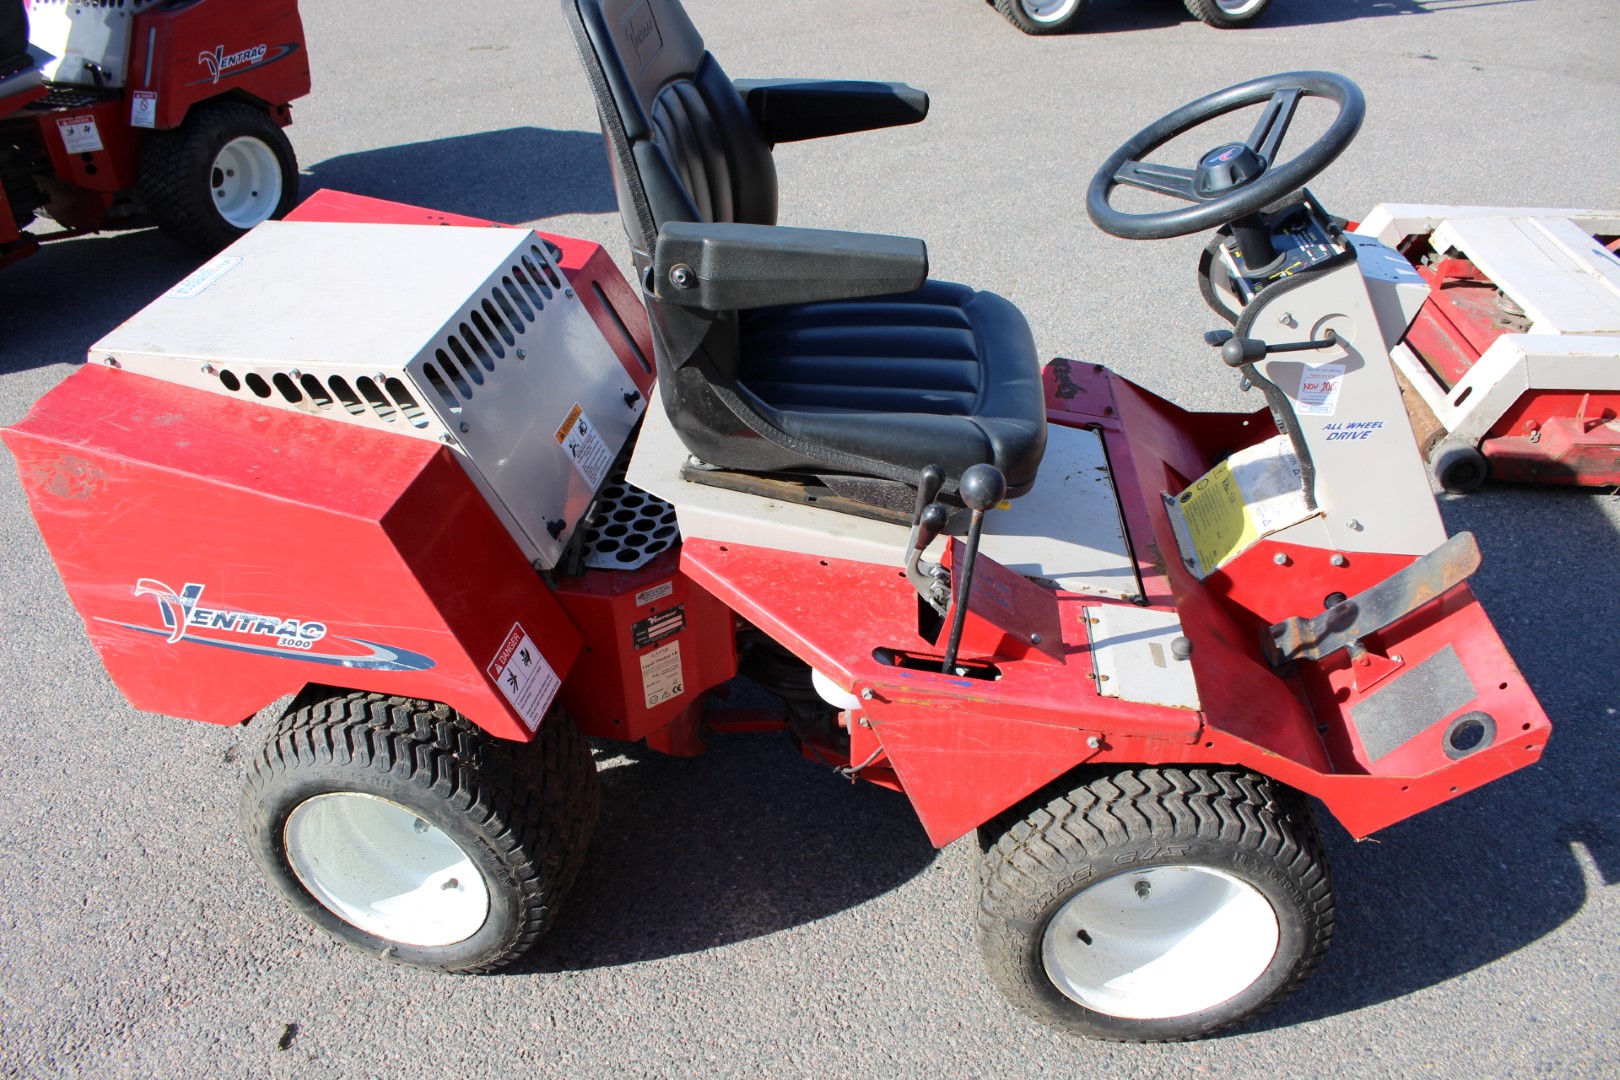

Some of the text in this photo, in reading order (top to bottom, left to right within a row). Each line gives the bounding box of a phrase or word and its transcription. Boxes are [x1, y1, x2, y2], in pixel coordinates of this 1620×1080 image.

[199, 44, 267, 84] VENTRAC
[1302, 381, 1319, 392] NOV
[1322, 421, 1385, 431] ALL WHEEL
[1325, 431, 1373, 441] DRIVE
[134, 578, 327, 644] VENTRAC
[278, 636, 311, 649] 3000
[499, 632, 521, 665] DANGER
